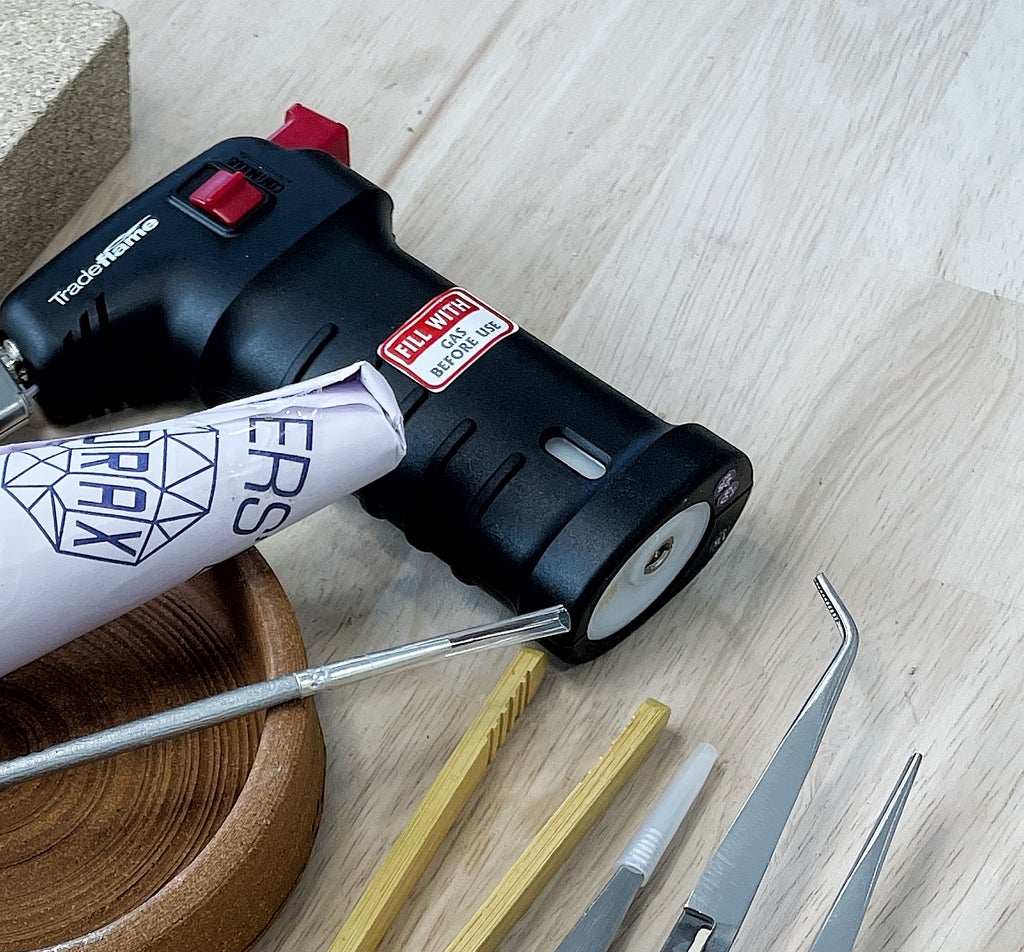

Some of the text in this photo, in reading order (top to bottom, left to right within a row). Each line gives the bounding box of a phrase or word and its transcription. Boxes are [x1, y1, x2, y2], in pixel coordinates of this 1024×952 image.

[47, 214, 159, 305] Tradeflame
[394, 298, 471, 359] FILL WITH
[430, 320, 502, 378] BEFORE USE
[440, 327, 467, 349] GAS
